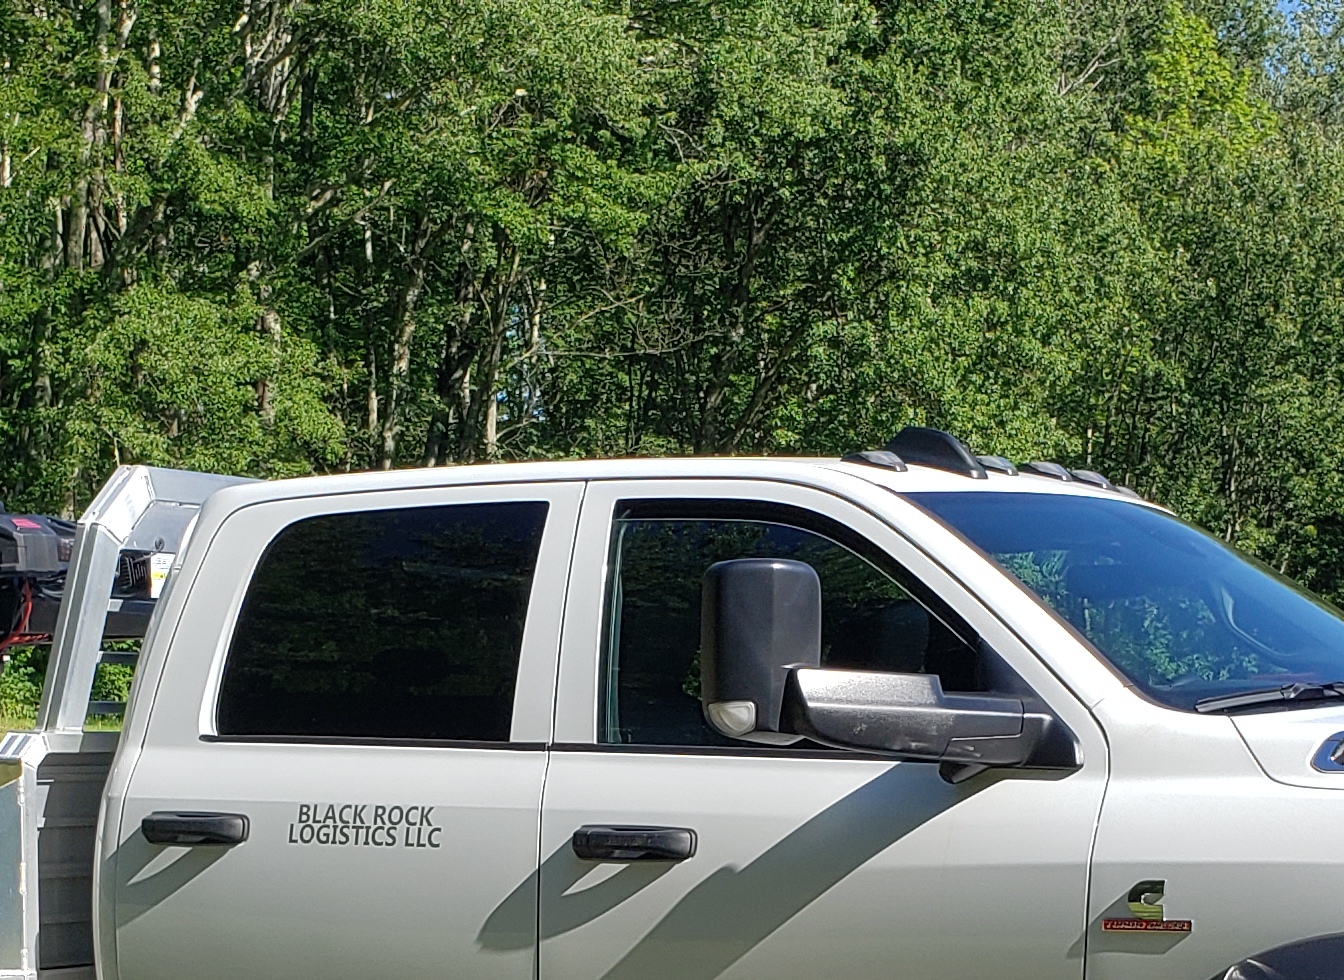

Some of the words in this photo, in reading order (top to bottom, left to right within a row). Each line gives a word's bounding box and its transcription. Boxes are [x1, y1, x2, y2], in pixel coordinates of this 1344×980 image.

[297, 803, 367, 825] BLACK
[373, 805, 435, 827] ROCK
[288, 823, 398, 847] LOGISTICS
[404, 826, 442, 848] LLC
